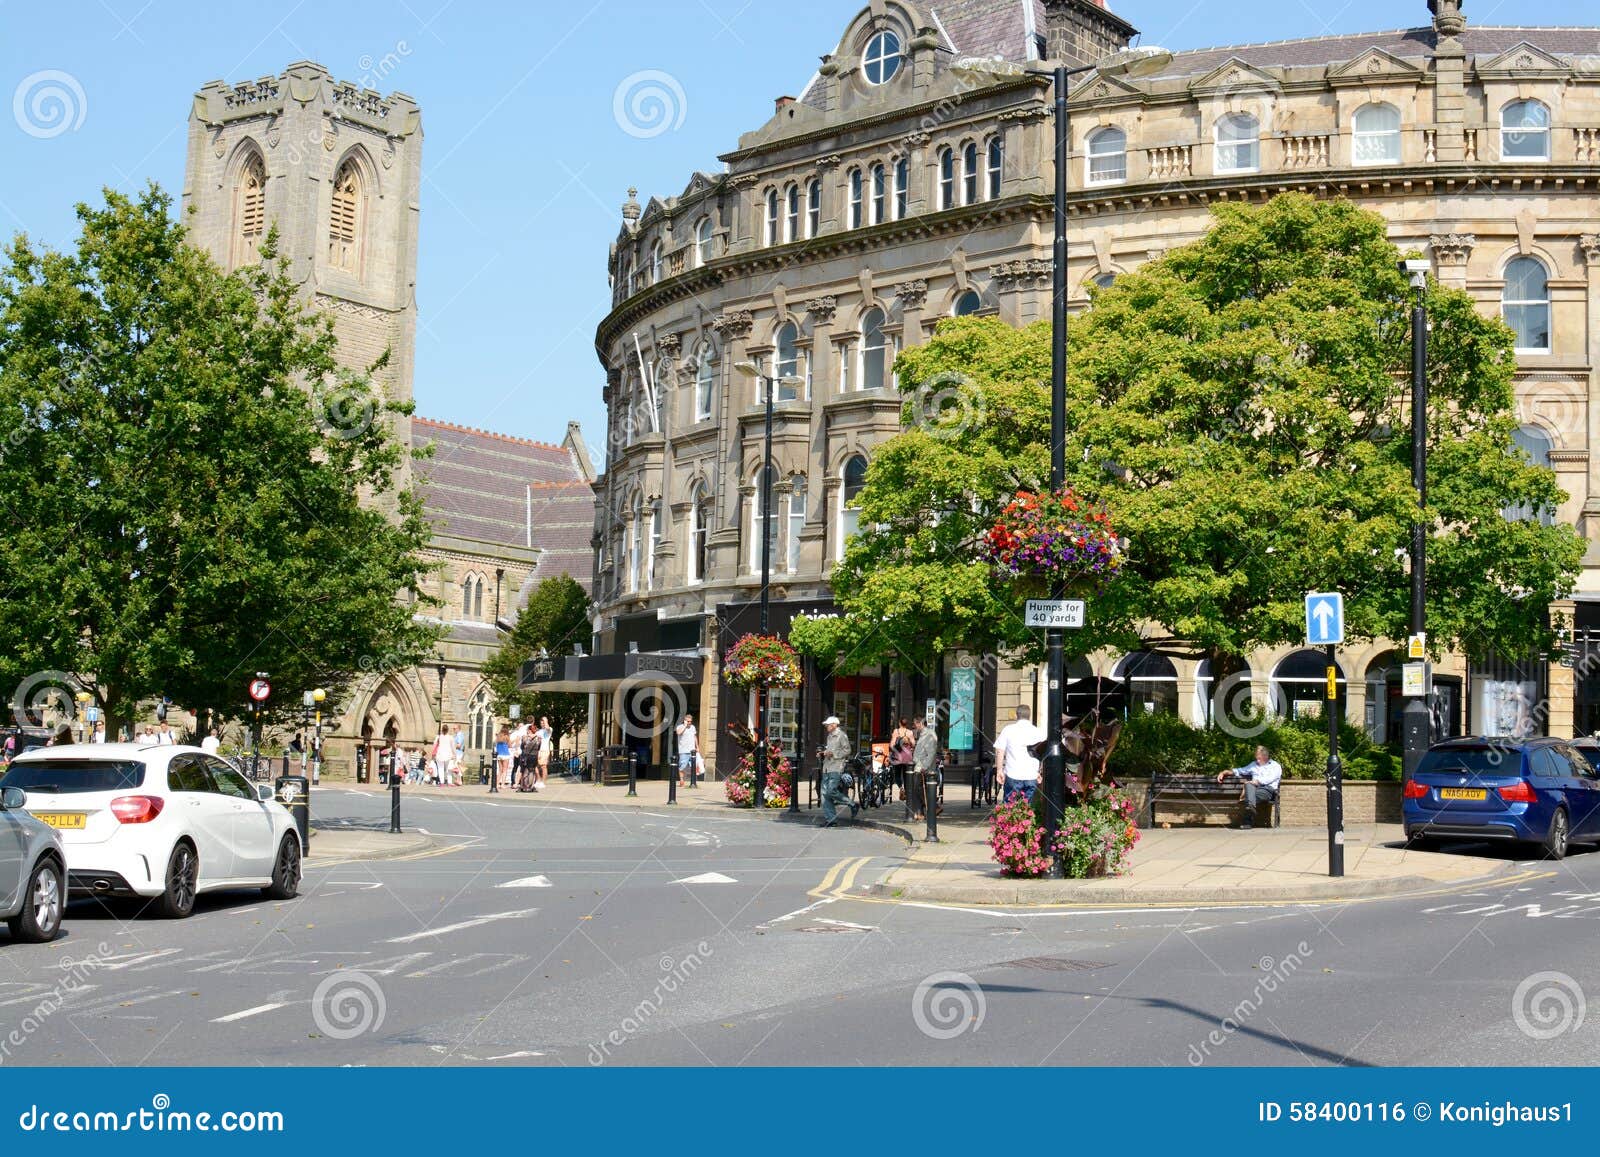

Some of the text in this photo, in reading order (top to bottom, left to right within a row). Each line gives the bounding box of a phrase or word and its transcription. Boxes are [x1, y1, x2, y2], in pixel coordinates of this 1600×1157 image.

[1029, 602, 1080, 612] Humps for
[1032, 613, 1076, 624] 40 yards
[637, 656, 694, 679] BRADLEYS
[59, 815, 81, 826] LLW
